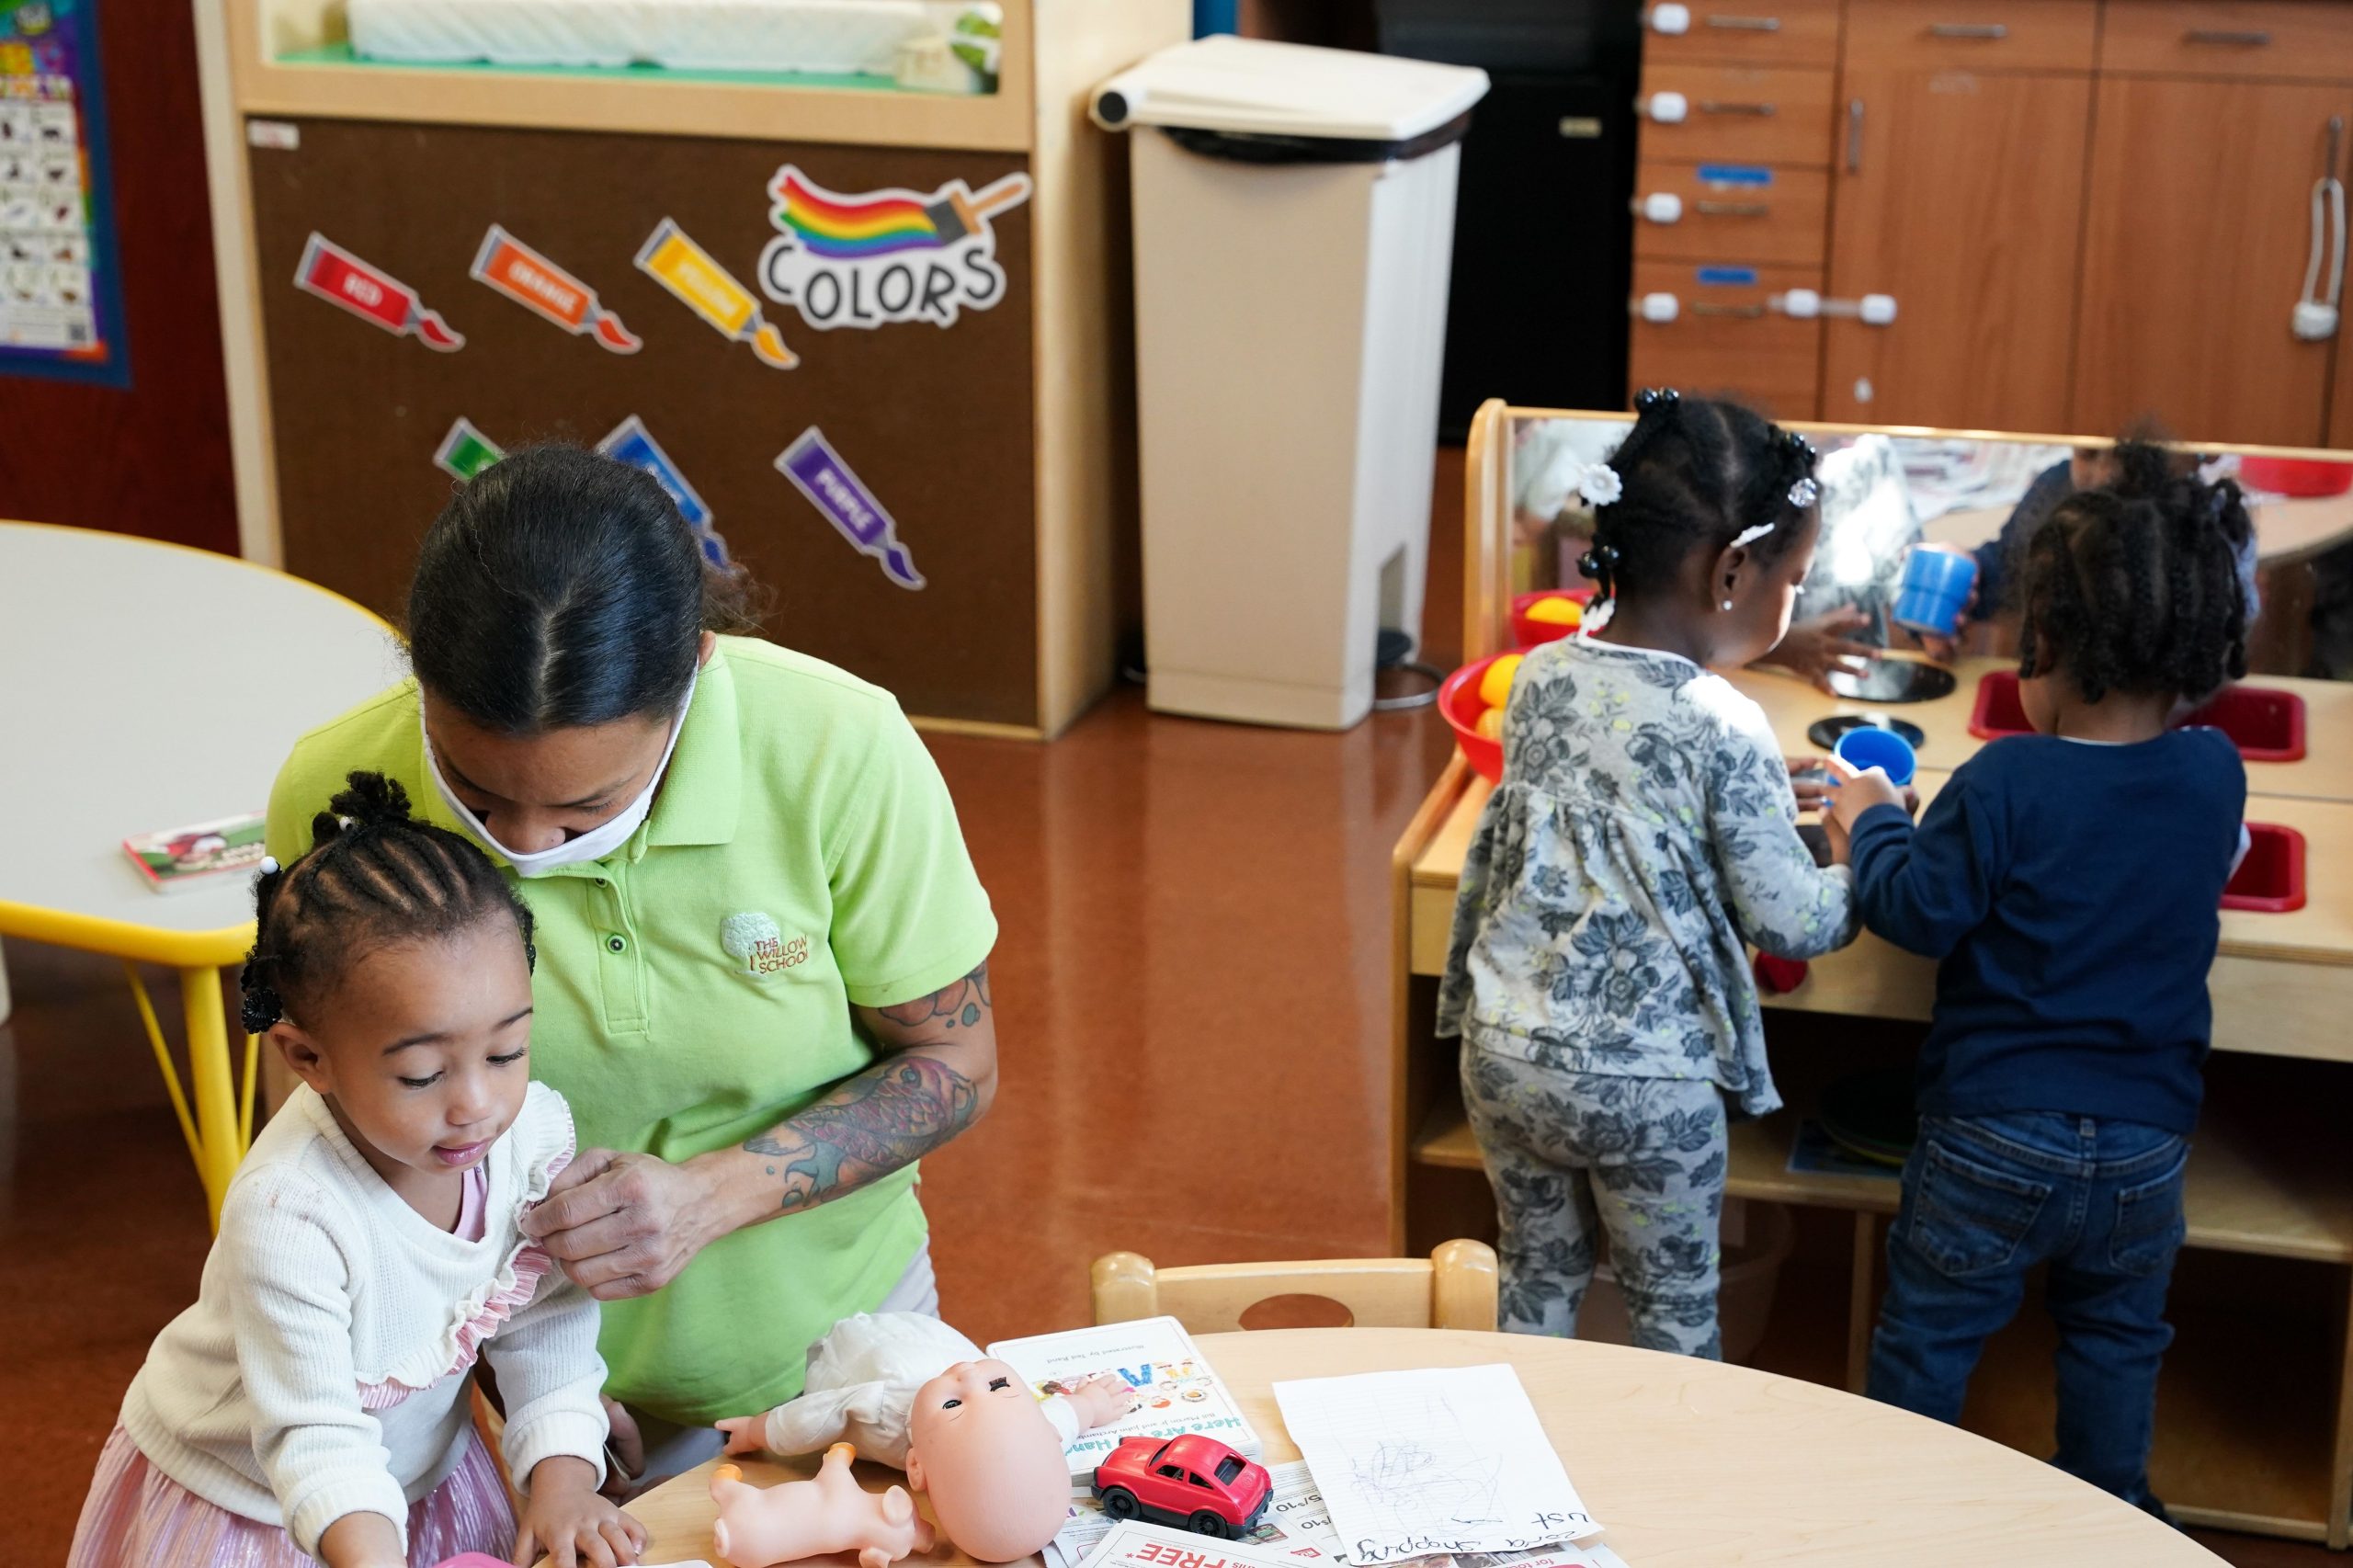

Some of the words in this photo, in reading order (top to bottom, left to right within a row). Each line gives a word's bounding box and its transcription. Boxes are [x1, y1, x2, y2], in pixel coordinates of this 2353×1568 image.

[342, 272, 384, 308] RED
[768, 244, 996, 321] COLORS
[814, 469, 874, 532] PURPLE
[754, 937, 779, 951] THE
[756, 934, 808, 961] WILLOW
[758, 950, 809, 974] SCHOOL
[1151, 1426, 1186, 1438] Are
[1190, 1416, 1242, 1431] Here
[1276, 1494, 1323, 1512] 5/$10
[1301, 1516, 1332, 1529] /$10
[1536, 1558, 1555, 1567] for
